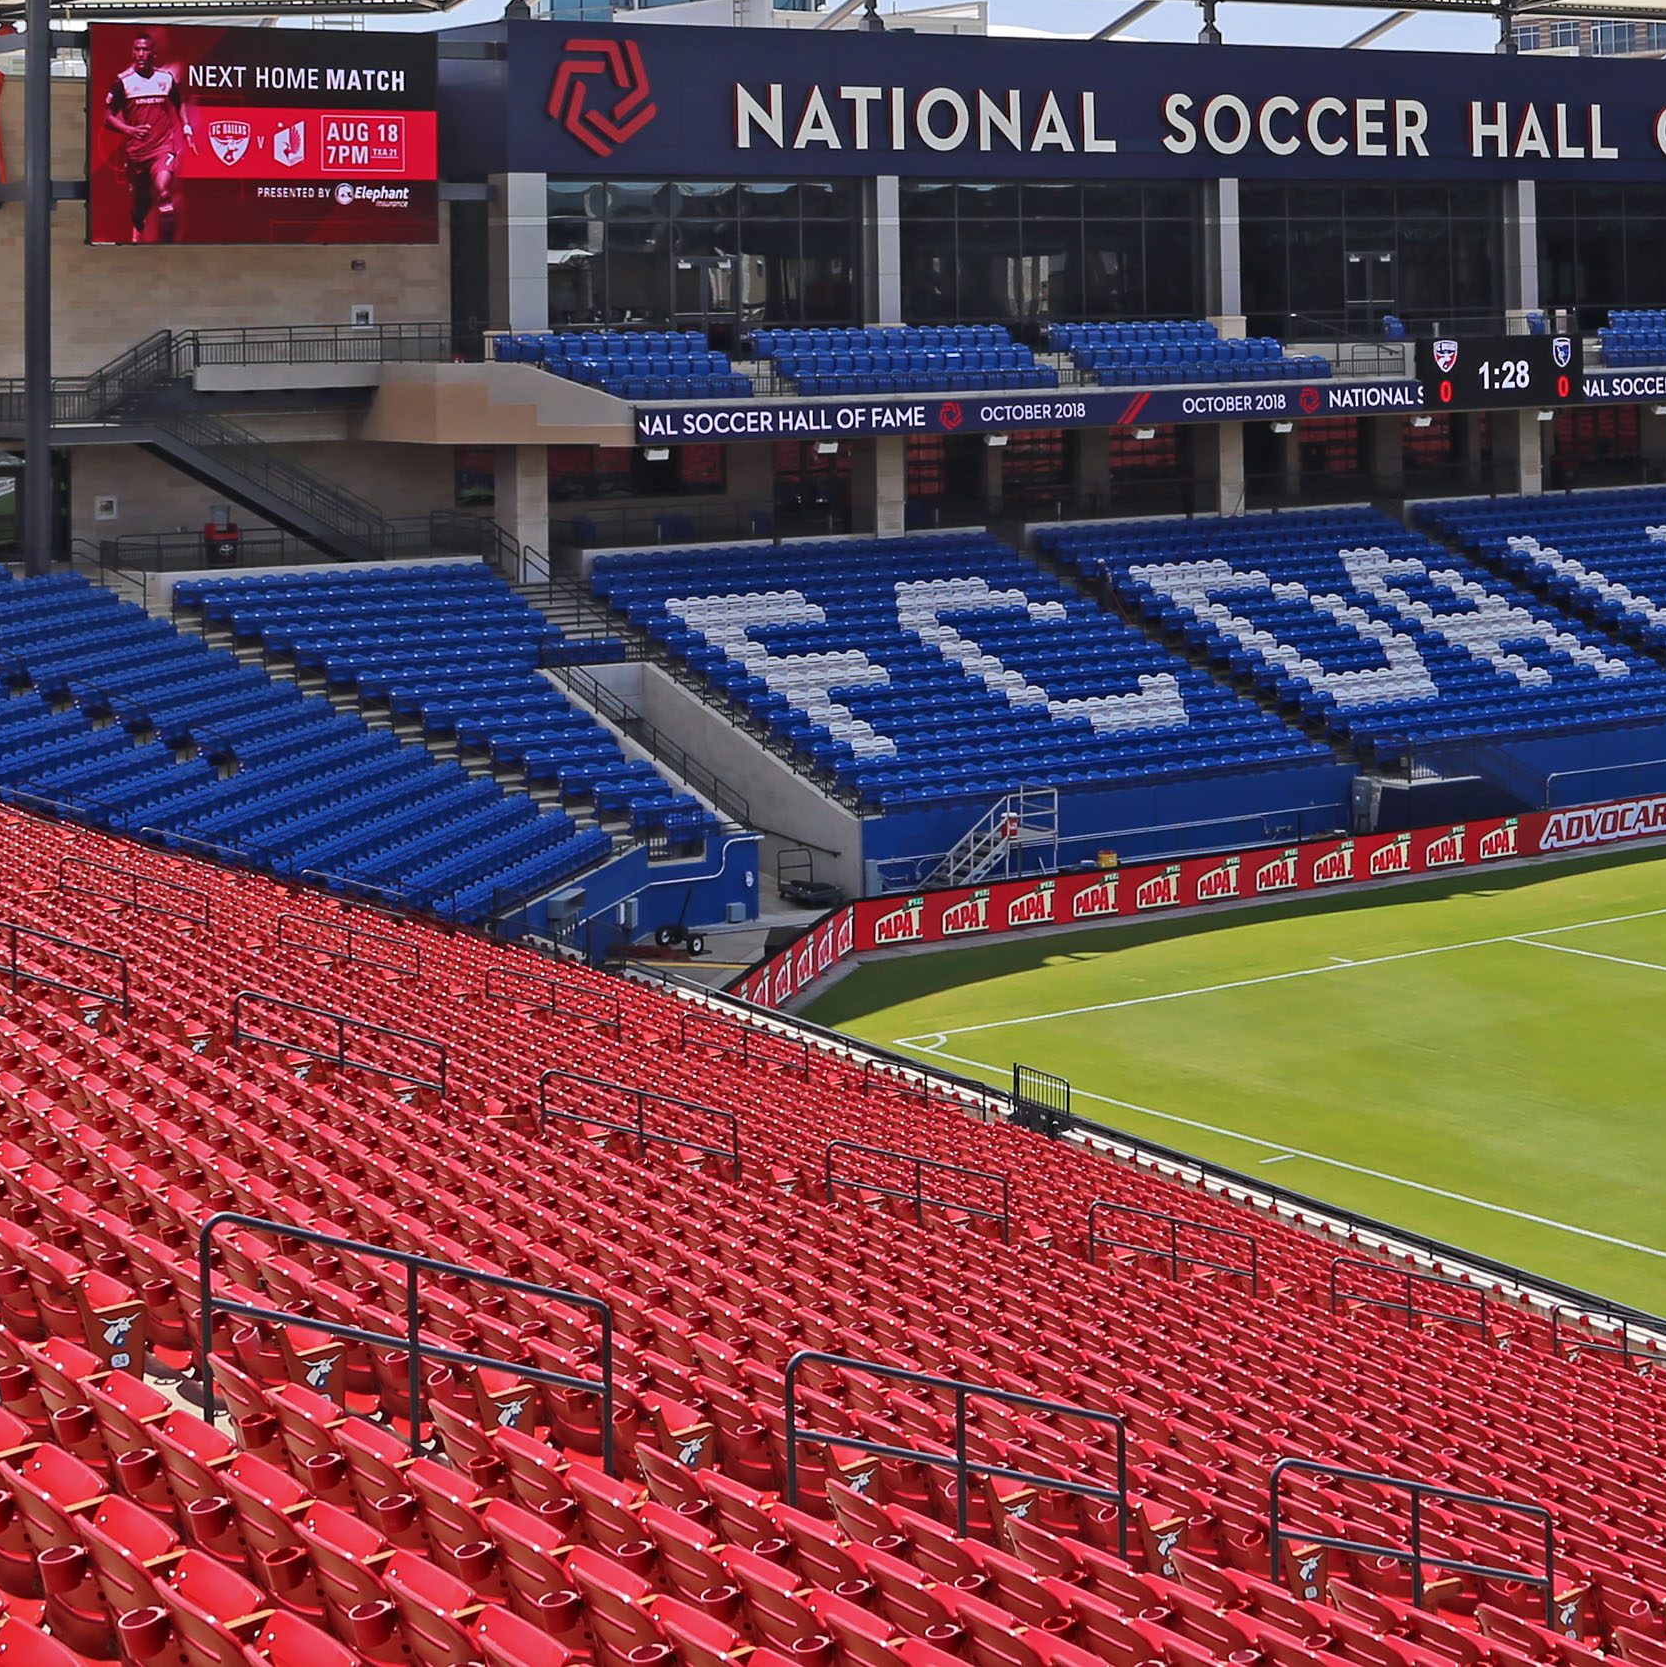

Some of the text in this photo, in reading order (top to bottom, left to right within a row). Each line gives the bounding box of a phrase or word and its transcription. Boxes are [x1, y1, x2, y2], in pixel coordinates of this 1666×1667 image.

[189, 65, 405, 92] NEXT HOME MATCH
[735, 82, 1116, 154] NATIONAL
[1163, 93, 1429, 158] SOCCER
[1470, 101, 1618, 160] HALL
[327, 122, 398, 142] AUG 18
[327, 145, 369, 164] 7PM
[257, 187, 331, 199] PRESENTED BY
[355, 186, 409, 205] Elephant
[1478, 360, 1530, 390] 1:28
[1439, 380, 1452, 403] 0
[1557, 375, 1570, 397] 0
[1183, 394, 1286, 414] OCTOBER 2018
[1328, 387, 1414, 408] NATIONAL
[682, 411, 773, 435] SOCCER
[779, 409, 832, 432] HALL
[836, 408, 866, 430] OF
[871, 405, 926, 428] FAME
[980, 402, 1086, 422] OCTOBER 2018
[114, 1355, 126, 1366] 24
